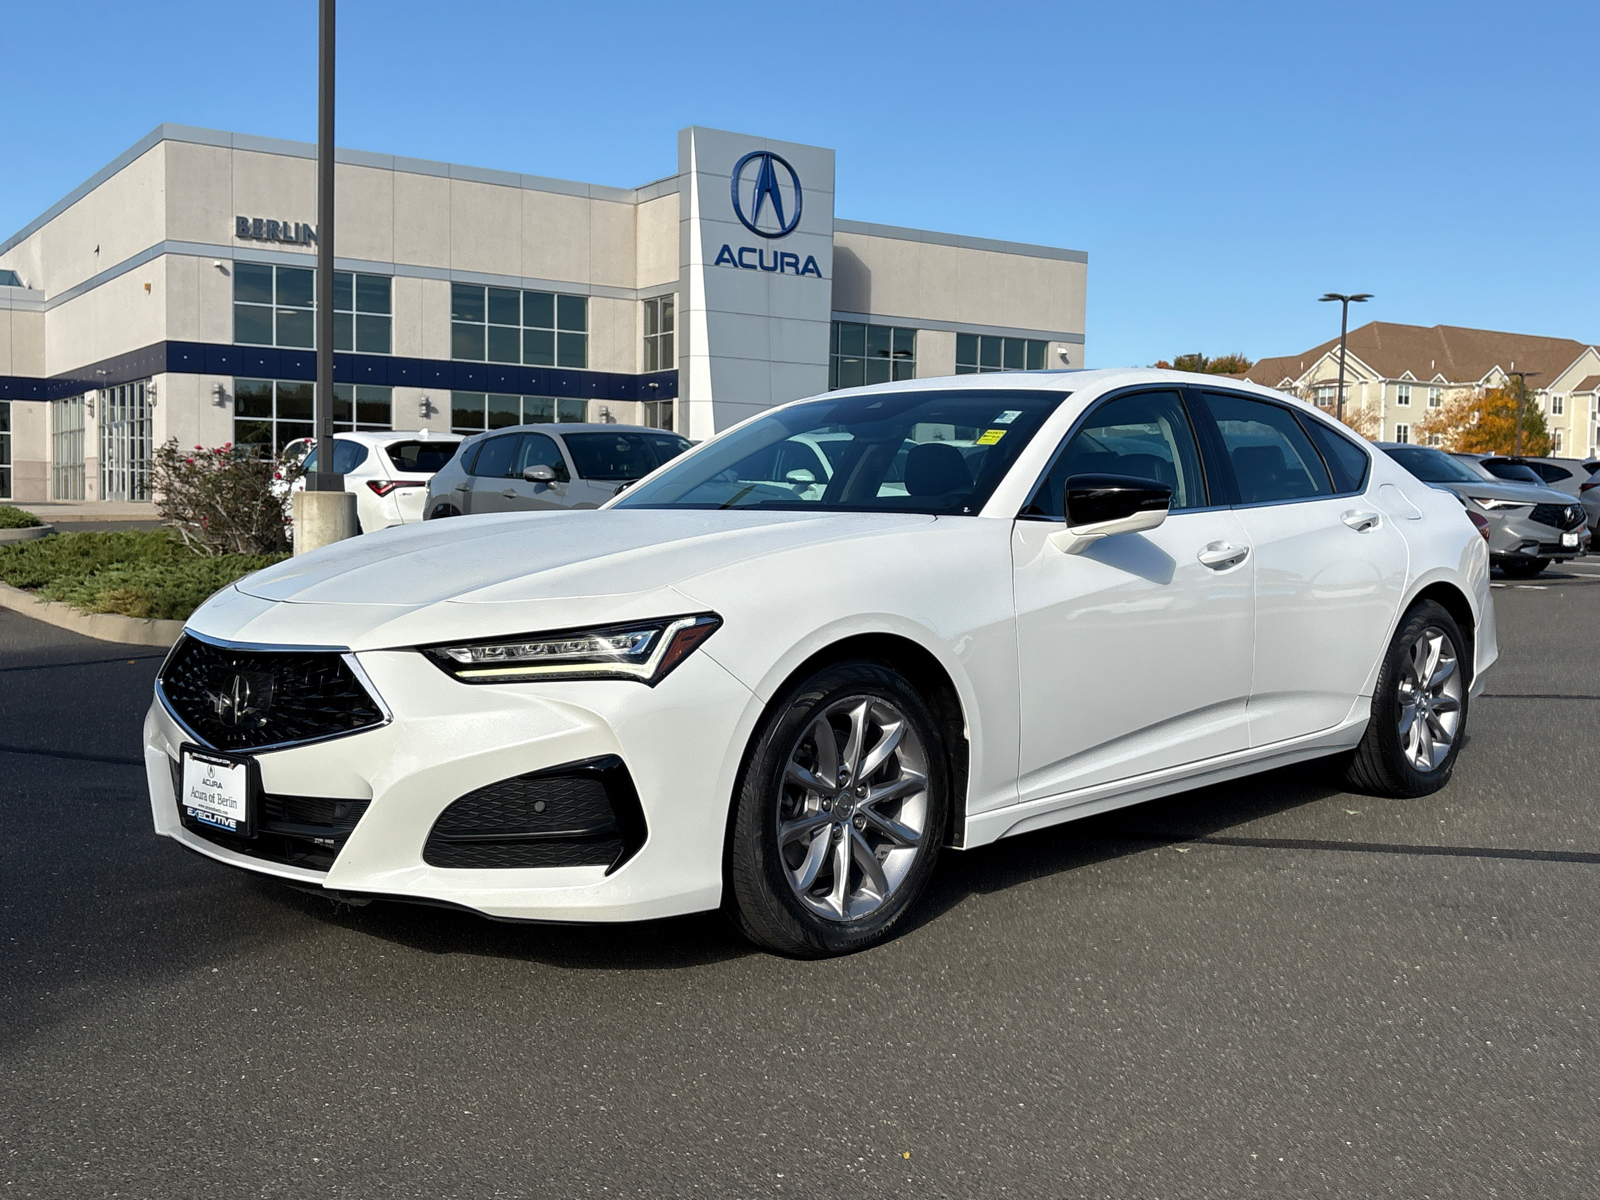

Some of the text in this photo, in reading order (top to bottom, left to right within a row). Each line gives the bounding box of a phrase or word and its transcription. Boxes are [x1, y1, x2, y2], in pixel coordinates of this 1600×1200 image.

[236, 216, 319, 244] BERLIN
[714, 244, 822, 278] ACURA
[202, 778, 223, 789] ACURA
[190, 786, 207, 802] Acura
[208, 792, 216, 804] of
[217, 792, 238, 810] Berlin
[187, 807, 236, 828] EXECUTIVE
